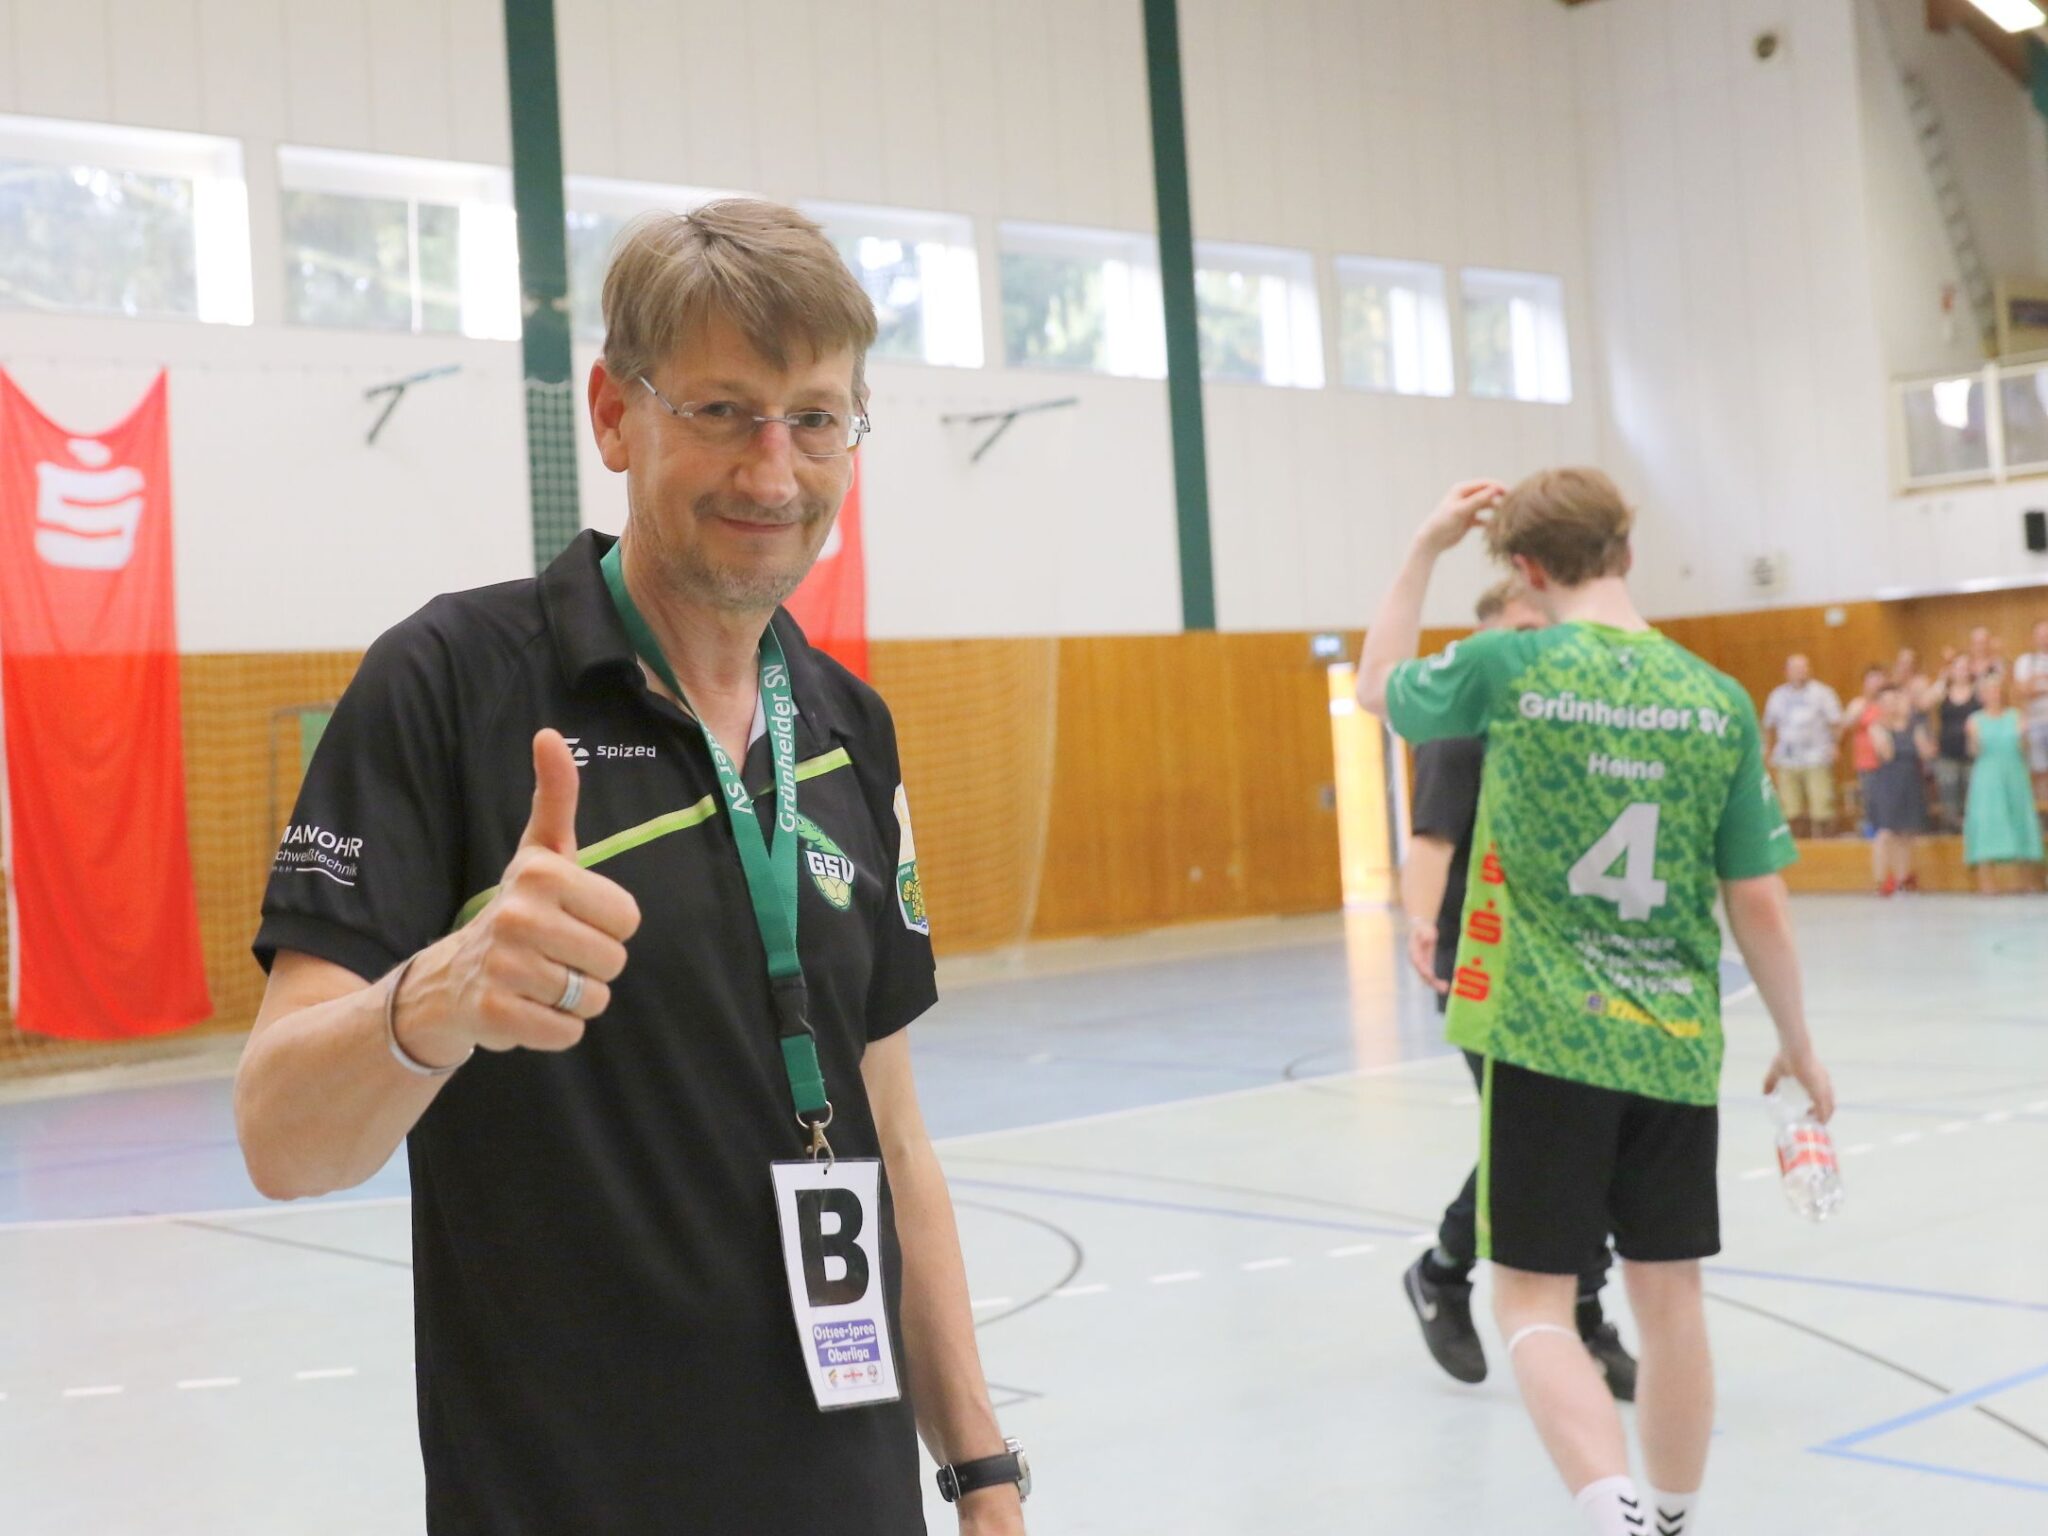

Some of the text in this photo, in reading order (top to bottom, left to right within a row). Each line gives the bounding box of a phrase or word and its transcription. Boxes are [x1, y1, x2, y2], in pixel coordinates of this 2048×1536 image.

[1519, 691, 1729, 738] Grünheider SV
[596, 743, 657, 759] spized
[763, 664, 796, 833] Grünheider SV
[1586, 752, 1666, 780] Heine
[726, 781, 753, 815] SV
[275, 848, 358, 877] chweißtechnik
[805, 850, 855, 885] GSV
[1567, 802, 1667, 922] 4
[795, 1188, 870, 1308] B
[813, 1322, 875, 1341] Ostsee-Spree
[827, 1346, 870, 1363] Oberliga
